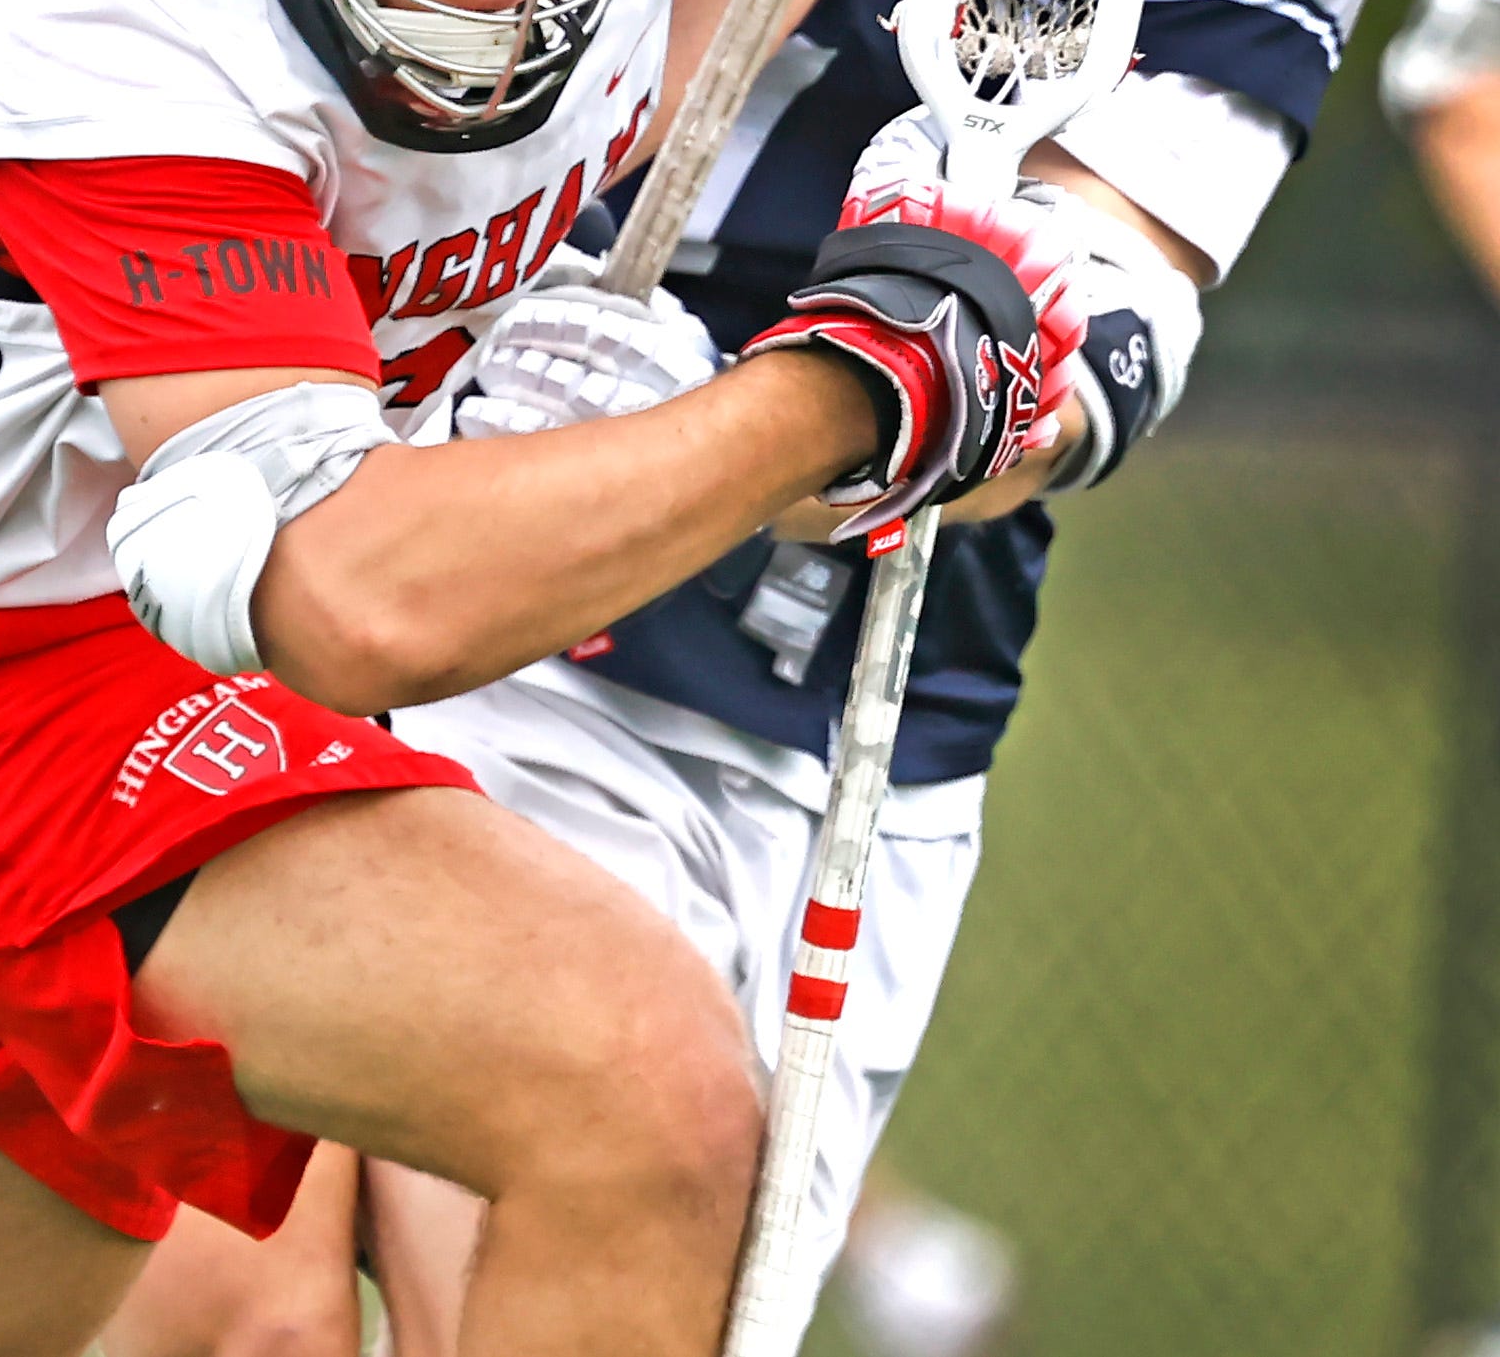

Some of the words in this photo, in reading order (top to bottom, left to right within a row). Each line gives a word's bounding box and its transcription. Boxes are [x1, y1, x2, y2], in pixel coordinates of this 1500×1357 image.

[963, 113, 1005, 135] STX
[119, 238, 332, 306] H-TOWN
[870, 529, 903, 553] STX
[191, 719, 268, 781] H
